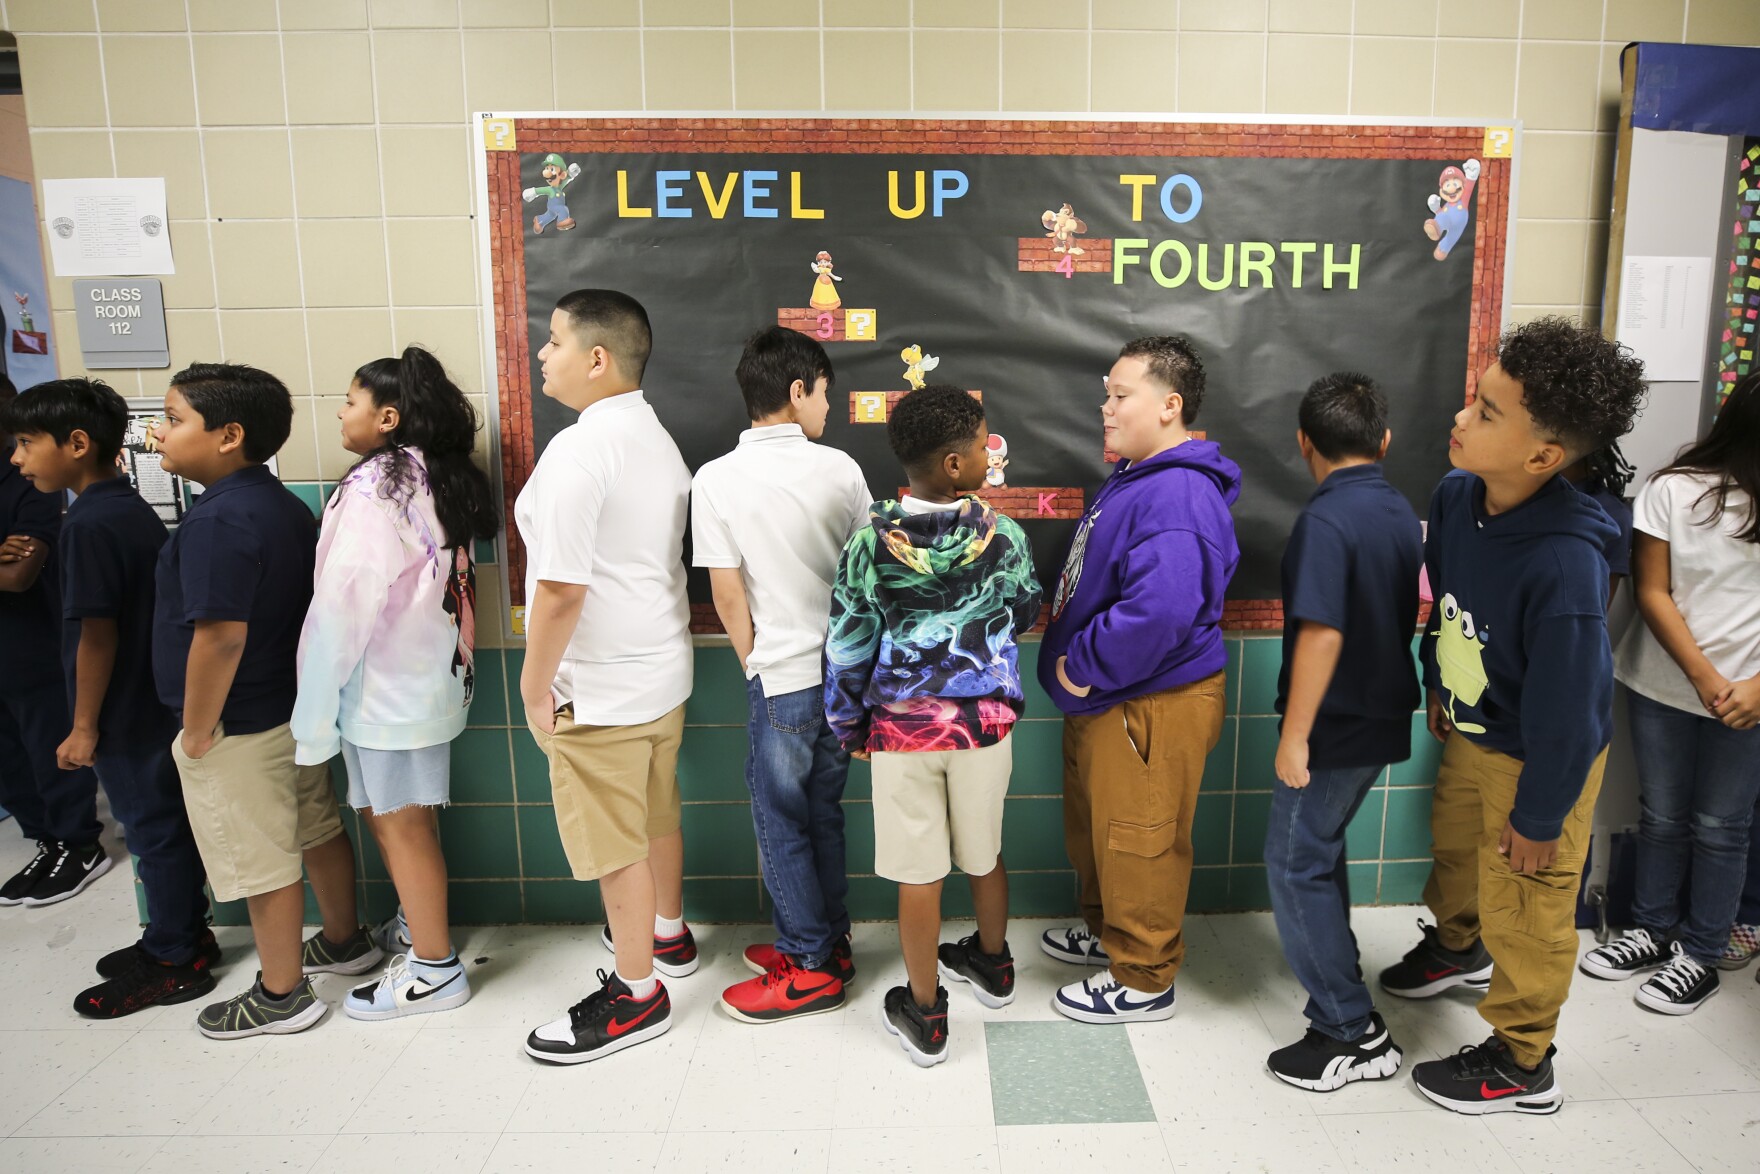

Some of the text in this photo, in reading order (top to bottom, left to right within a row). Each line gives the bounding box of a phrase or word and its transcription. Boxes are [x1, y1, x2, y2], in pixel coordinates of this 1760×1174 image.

[616, 169, 1203, 223] LEVEL UP TO
[1055, 254, 1074, 279] 4
[1113, 238, 1361, 291] FOURTH
[90, 287, 142, 302] CLASS
[95, 304, 142, 318] ROOM
[108, 321, 132, 335] 112
[816, 312, 834, 339] 3
[1037, 492, 1058, 515] K
